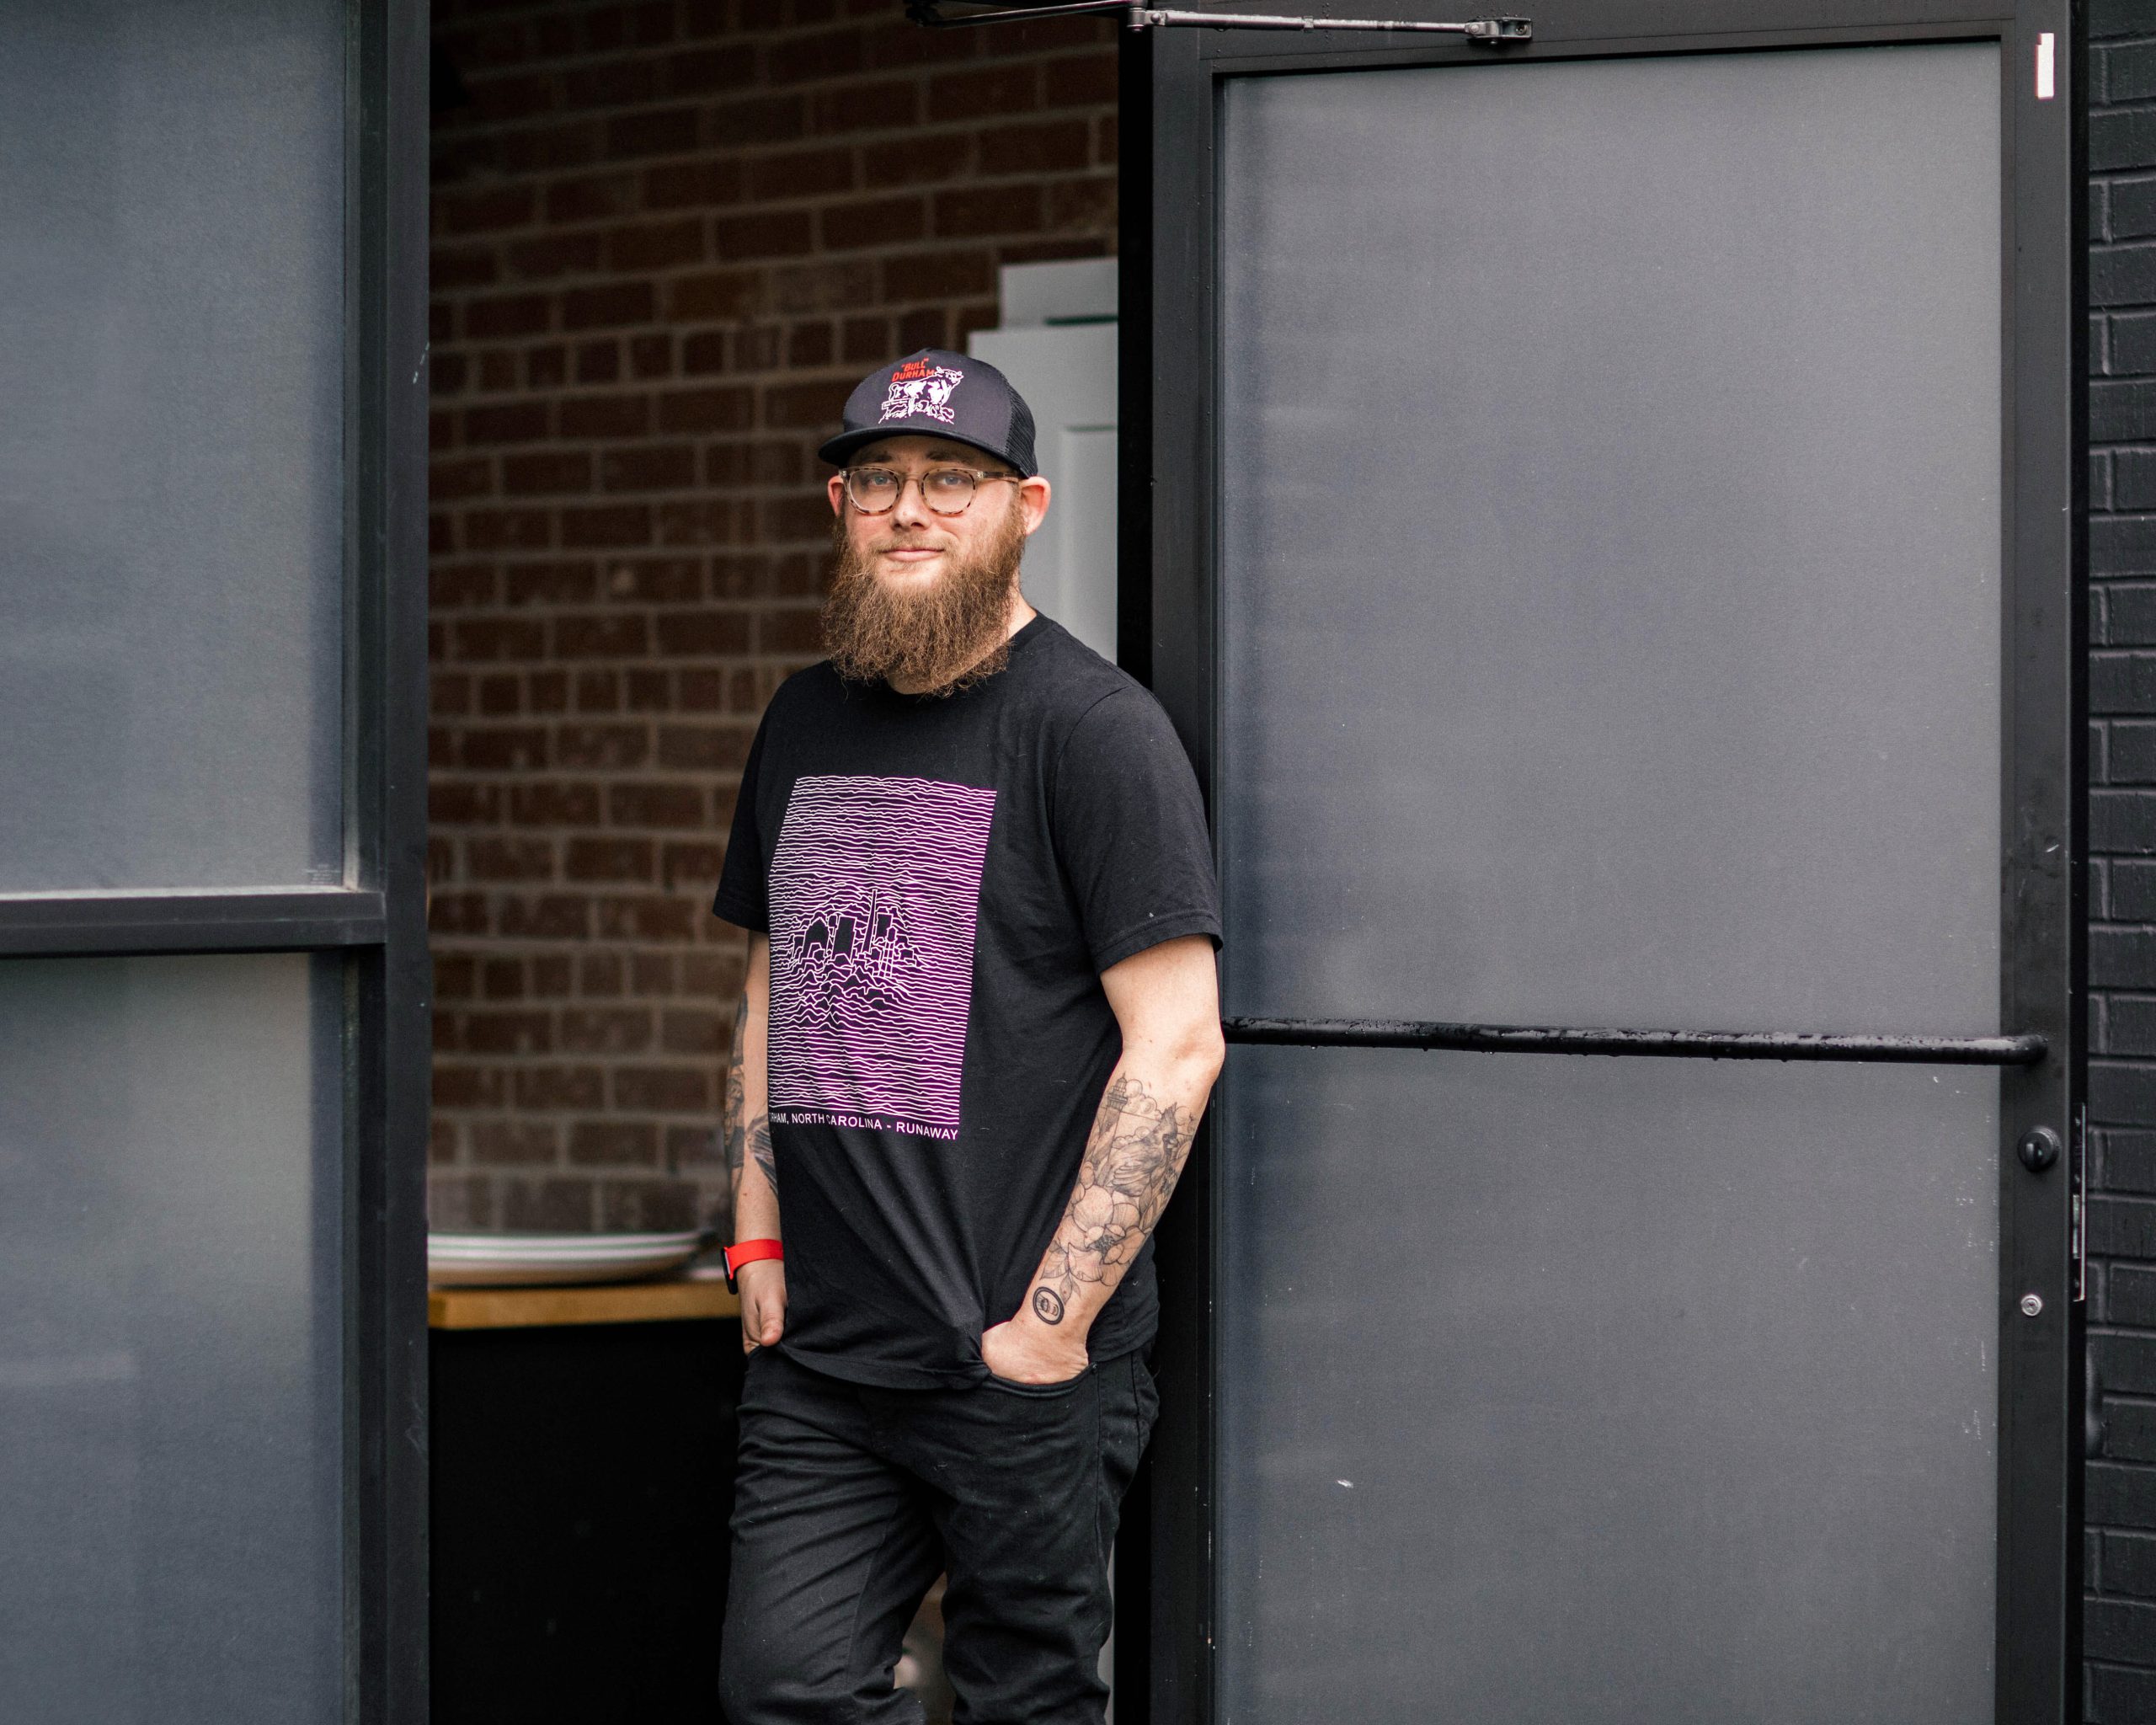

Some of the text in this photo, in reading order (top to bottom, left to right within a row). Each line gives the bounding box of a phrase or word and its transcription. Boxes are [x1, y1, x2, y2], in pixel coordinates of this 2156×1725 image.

[892, 369, 935, 382] DURHAM
[791, 1113, 825, 1124] NORTH
[826, 1114, 883, 1130] CAROLINA
[896, 1121, 958, 1140] RUNAWAY
